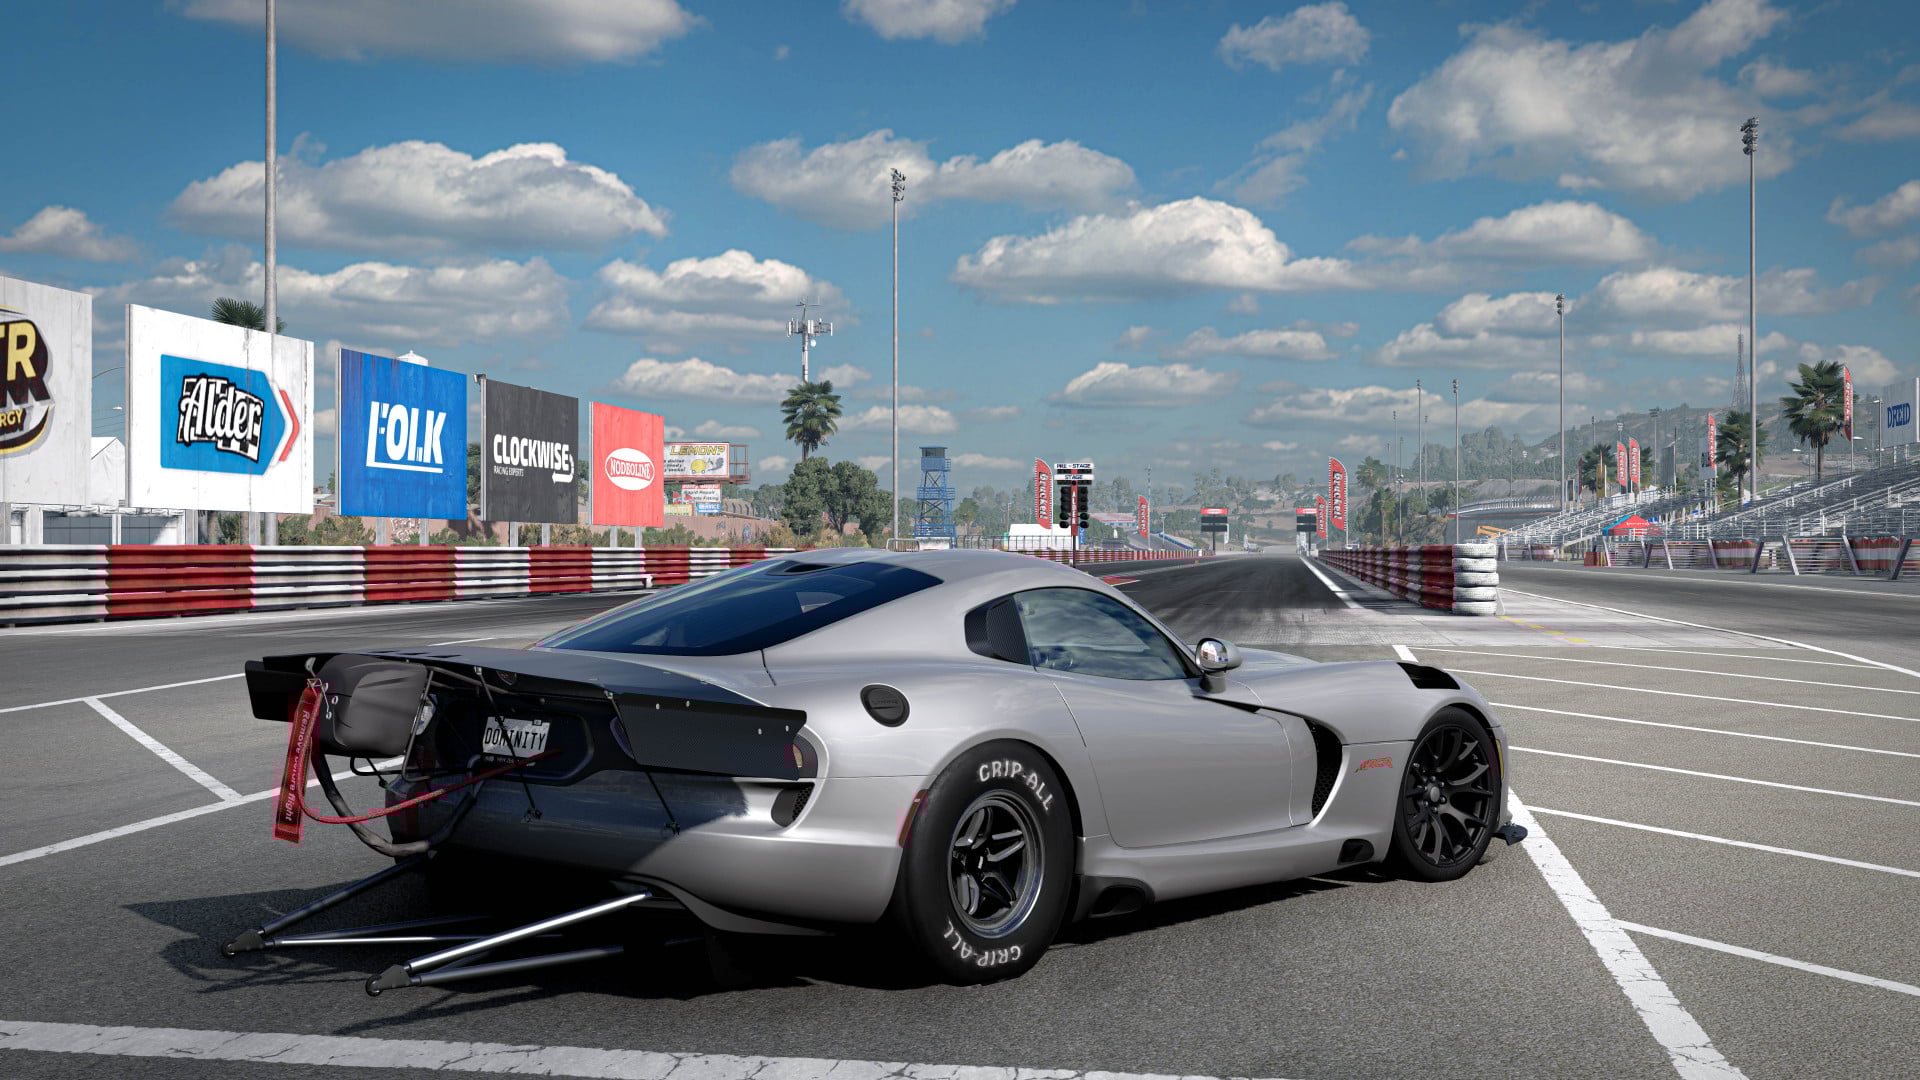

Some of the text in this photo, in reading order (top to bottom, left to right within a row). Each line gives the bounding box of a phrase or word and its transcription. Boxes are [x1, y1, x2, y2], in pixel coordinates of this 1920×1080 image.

[0, 322, 36, 381] R
[181, 377, 262, 442] Alder
[366, 401, 447, 473] FOLK
[493, 433, 570, 471] CLOCKWISE
[1038, 471, 1048, 519] Bruckell
[1333, 471, 1343, 520] Bruckell
[296, 710, 310, 753] Remove
[285, 793, 296, 821] flight
[978, 760, 1054, 811] GRIP-ALL
[943, 920, 1022, 967] GRIP-ALL
